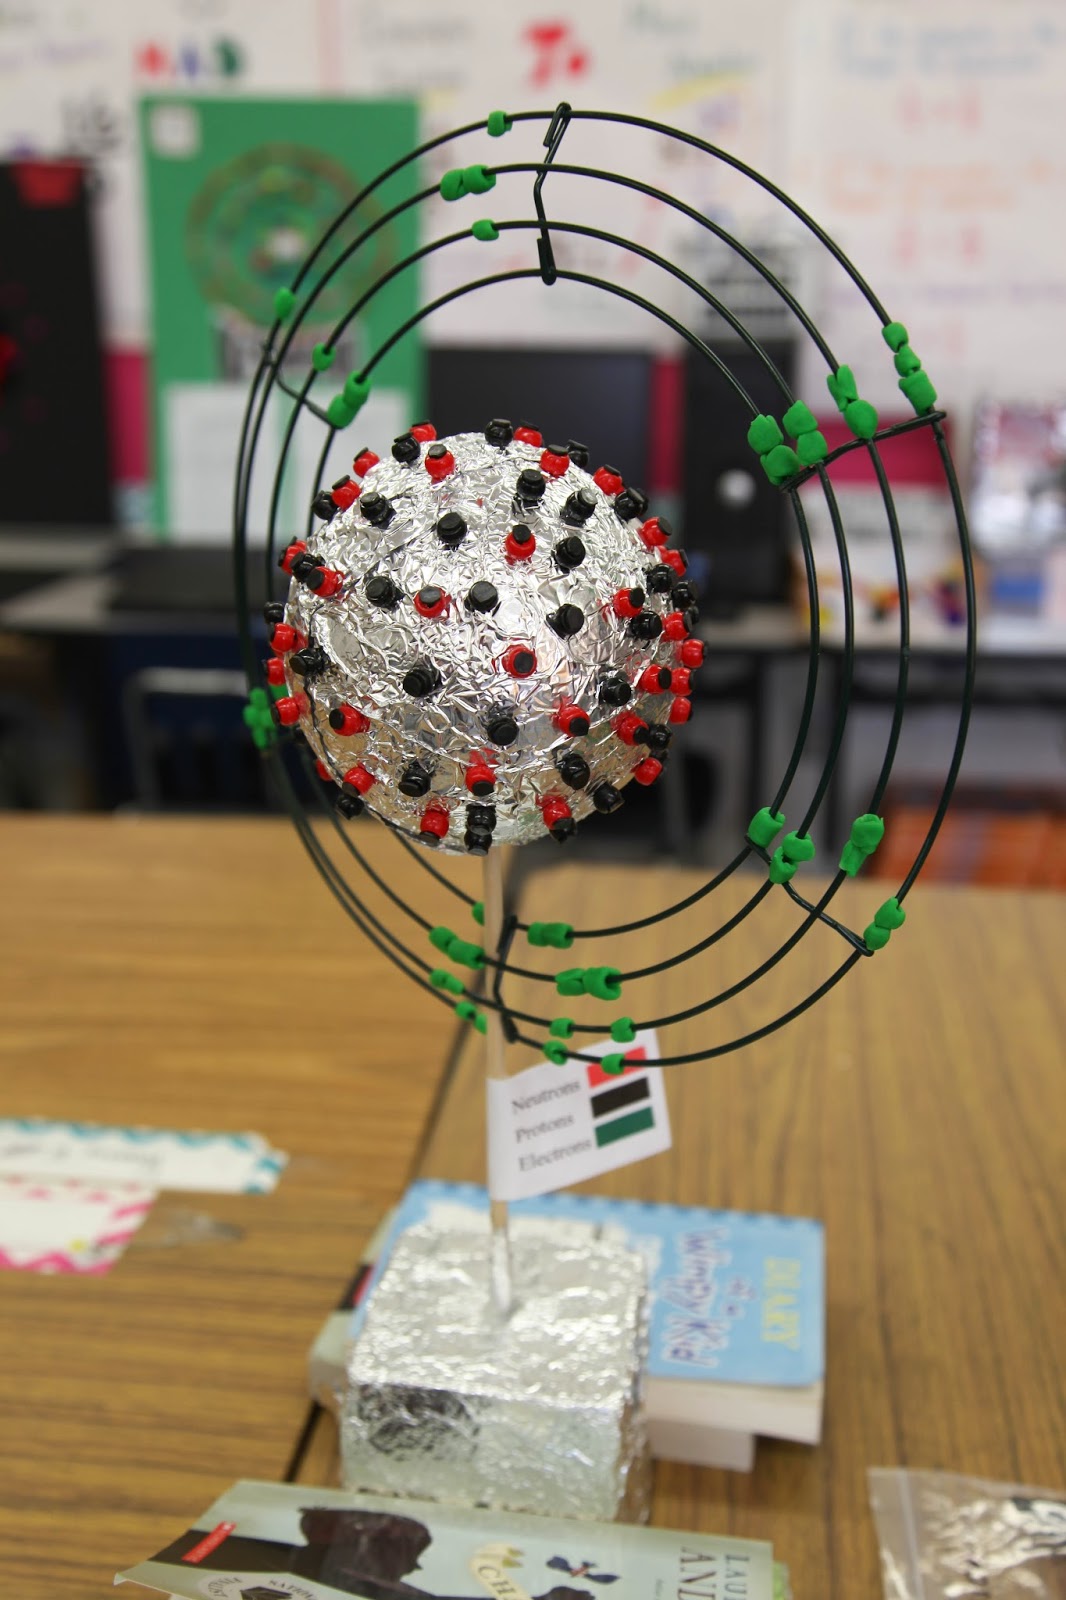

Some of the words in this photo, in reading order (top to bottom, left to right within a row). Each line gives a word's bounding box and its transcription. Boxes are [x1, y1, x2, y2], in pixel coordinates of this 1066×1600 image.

[511, 1080, 581, 1116] Neutrons
[515, 1115, 574, 1145] Protons
[518, 1139, 592, 1172] Electrons
